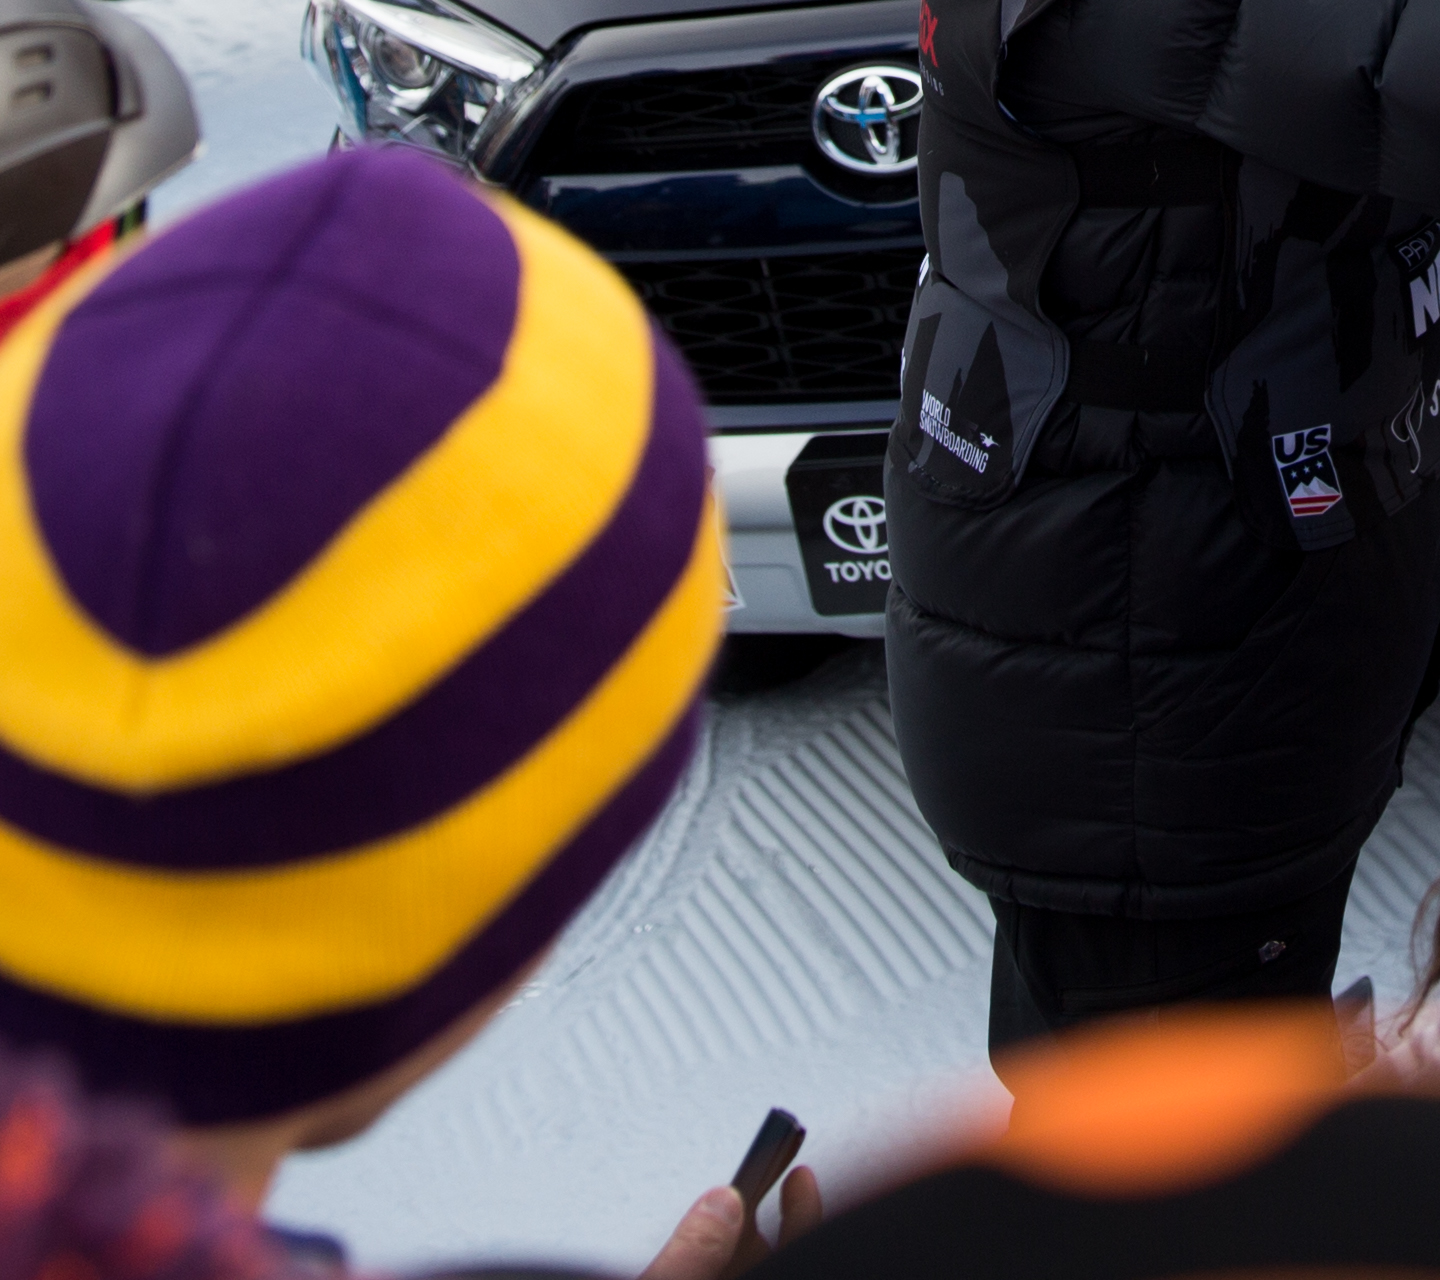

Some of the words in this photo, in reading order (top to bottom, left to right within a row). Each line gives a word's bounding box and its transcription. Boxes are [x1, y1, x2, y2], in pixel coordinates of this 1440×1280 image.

[921, 388, 952, 428] WORLD
[918, 408, 990, 474] SNOWBOARDING
[1274, 425, 1330, 466] US
